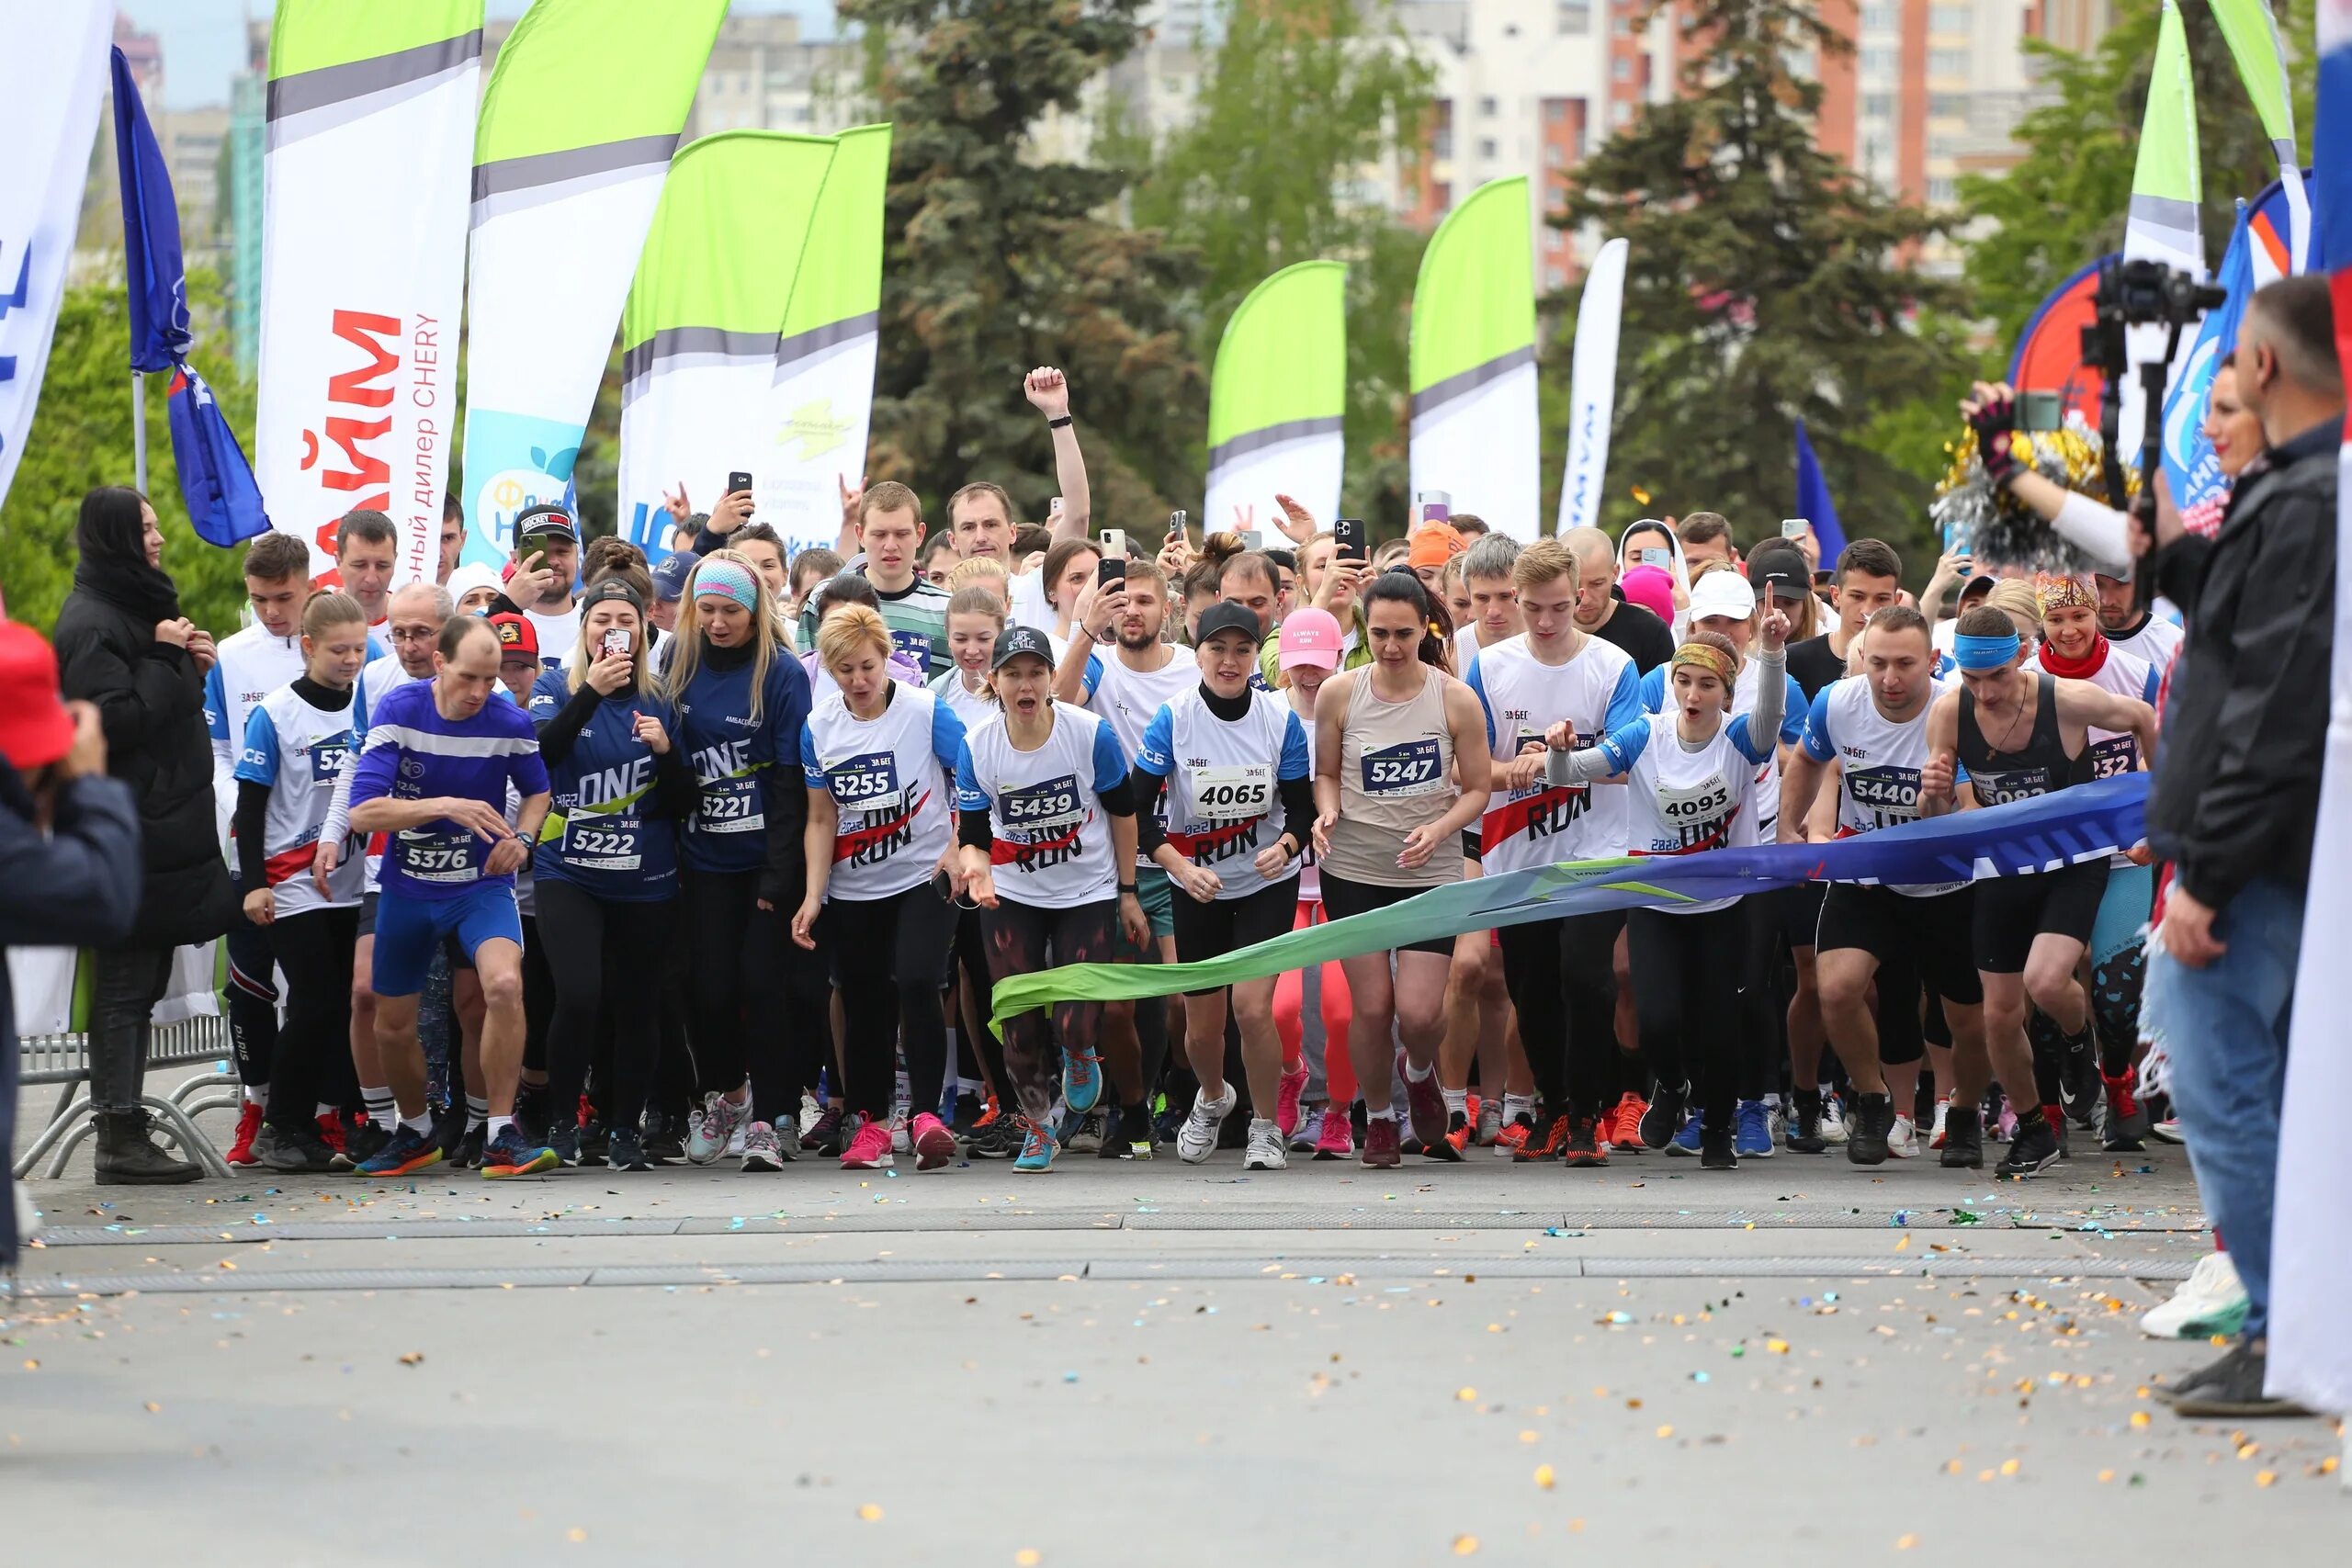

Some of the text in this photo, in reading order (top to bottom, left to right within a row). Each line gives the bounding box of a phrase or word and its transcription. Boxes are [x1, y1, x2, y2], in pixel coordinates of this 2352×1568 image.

[413, 313, 438, 408] CHERY
[300, 309, 401, 588] АЙМ
[415, 418, 438, 507] дилер
[523, 514, 548, 530] HOCKEY
[239, 749, 266, 766] СБ
[319, 749, 347, 771] 52
[880, 757, 891, 766] БЕГ
[1416, 745, 1436, 755] ЗА БЕГ
[579, 755, 651, 809] ONE
[1063, 779, 1073, 787] БЕГ
[1370, 759, 1434, 783] 5247
[1898, 773, 1907, 781] ЗА
[1907, 773, 1918, 782] БЕГ
[834, 772, 889, 796] 5255
[956, 786, 981, 802] СБ
[1199, 784, 1266, 806] 4065
[1854, 780, 1917, 806] 5440
[702, 795, 751, 818] 5221
[1009, 794, 1072, 818] 5439
[1527, 781, 1592, 841] RUN
[1665, 786, 1728, 817] 4093
[572, 829, 635, 855] 5222
[850, 821, 912, 870] RUN
[1015, 834, 1083, 874] RUN
[1195, 823, 1259, 868] RUN
[406, 847, 469, 869] 5376
